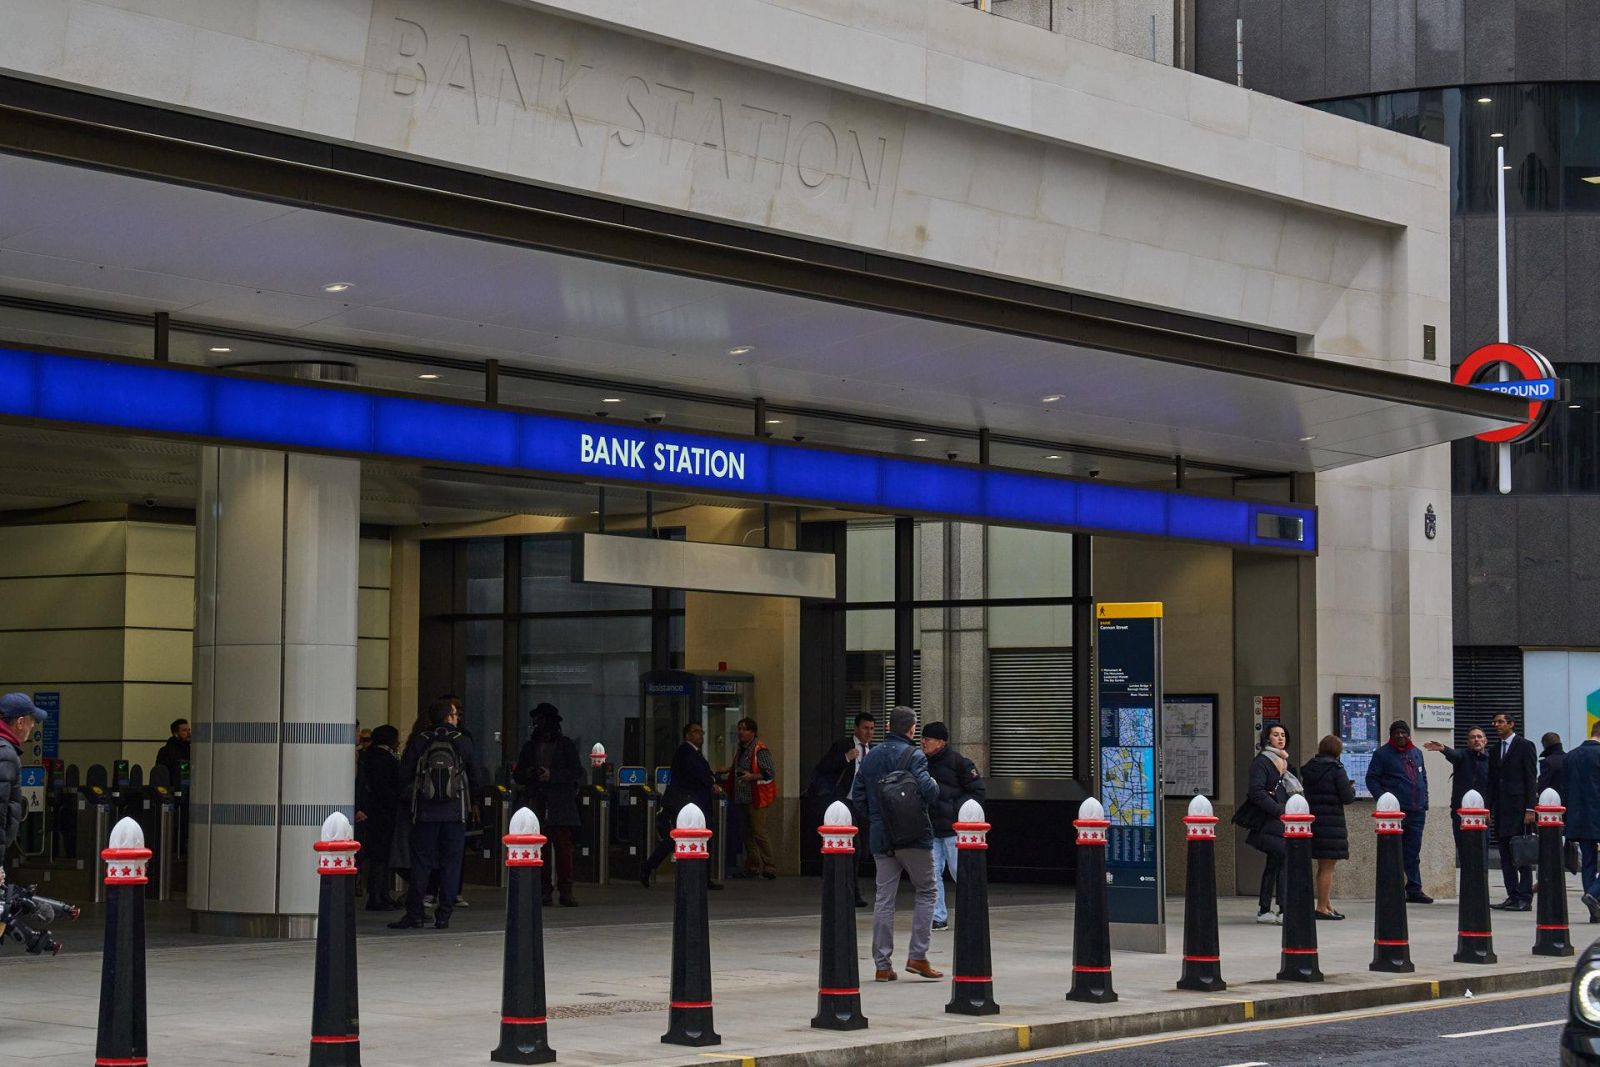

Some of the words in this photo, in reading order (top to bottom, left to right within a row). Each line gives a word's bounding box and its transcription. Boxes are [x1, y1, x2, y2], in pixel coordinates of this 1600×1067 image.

[393, 17, 593, 148] BANK
[610, 75, 886, 209] STATION
[581, 433, 646, 469] BANK
[653, 442, 745, 480] STATION
